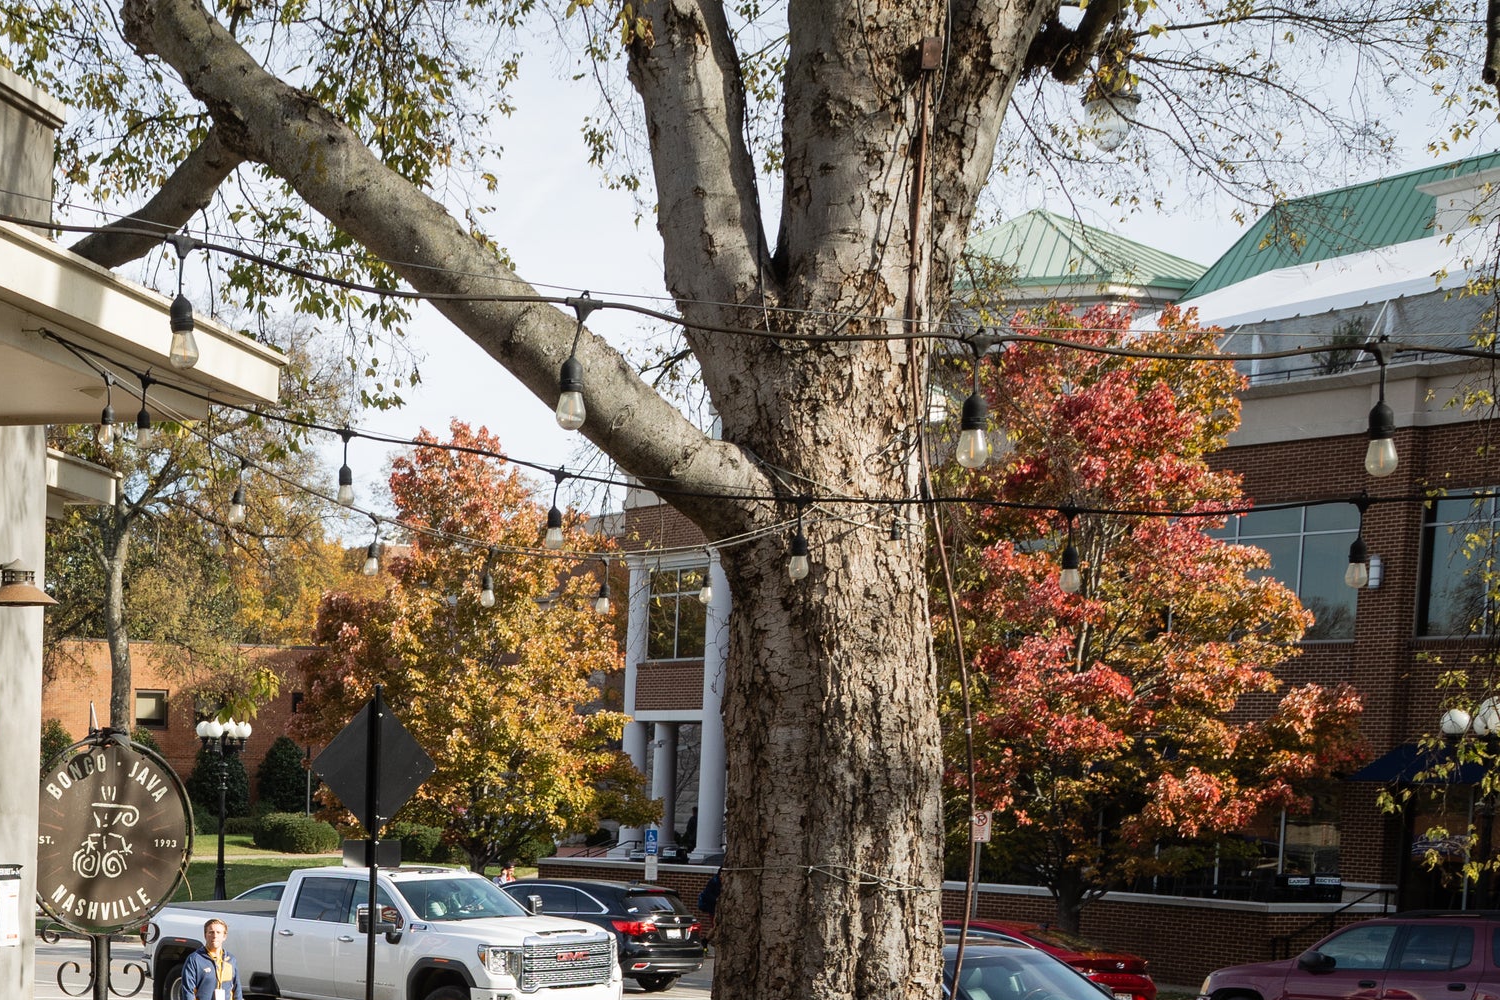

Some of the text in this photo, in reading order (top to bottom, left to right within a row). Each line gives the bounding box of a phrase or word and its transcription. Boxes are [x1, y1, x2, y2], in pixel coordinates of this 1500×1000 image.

[46, 754, 168, 802] BONGO JAVA
[39, 836, 55, 845] ST.
[154, 839, 177, 848] 1993
[51, 884, 151, 921] NASHVILLE
[556, 951, 591, 962] GMC
